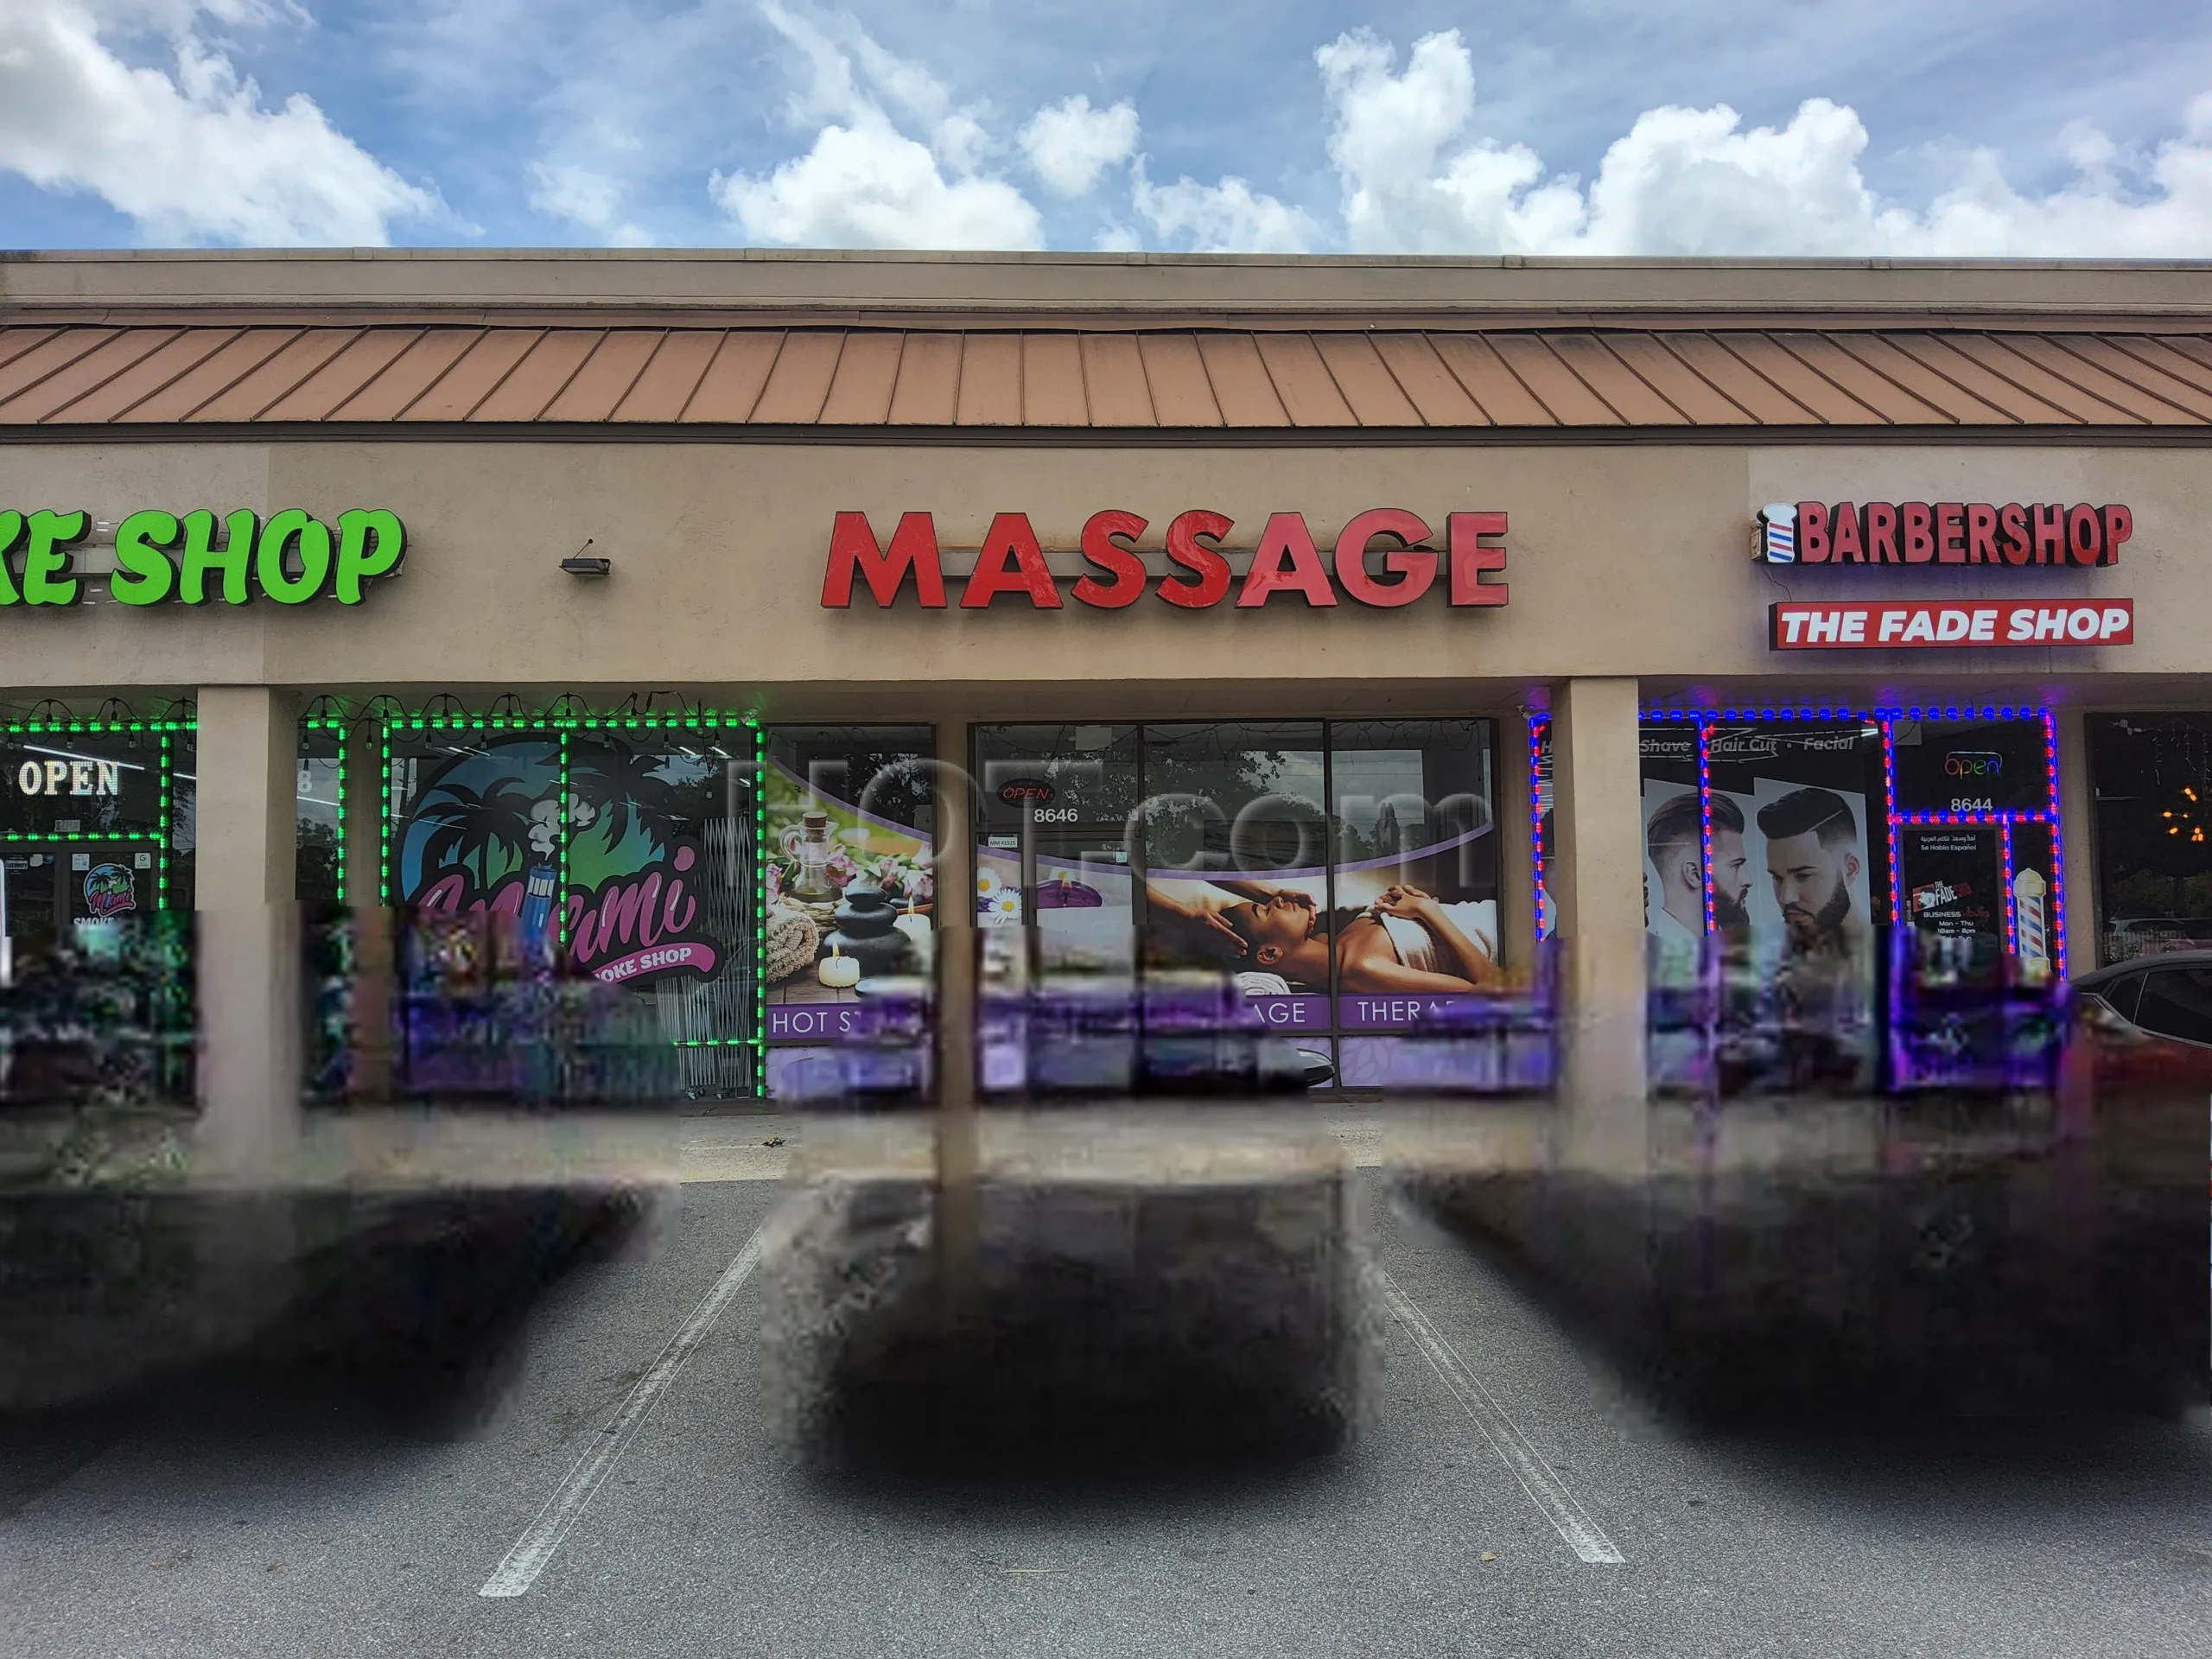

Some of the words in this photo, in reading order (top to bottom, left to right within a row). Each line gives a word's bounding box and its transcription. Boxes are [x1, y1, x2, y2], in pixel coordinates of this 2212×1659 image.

[1797, 501, 2133, 568] BARBERSHOP
[111, 508, 408, 606] SHOP
[819, 507, 1508, 609] MASSAGE
[1781, 611, 1867, 643] THE
[1878, 609, 1998, 642] FADE
[2007, 608, 2130, 640] SHOP
[1640, 738, 1690, 753] Shave
[1710, 738, 1745, 753] Hair
[1749, 737, 1777, 752] Cut
[1803, 736, 1854, 751] Facial
[18, 760, 118, 796] OPEN
[1002, 785, 1051, 800] OPEN
[1033, 808, 1079, 823] 8646
[1950, 798, 1993, 812] 8644
[1950, 843, 1977, 852] Español
[1935, 880, 1944, 889] THE
[1935, 886, 1958, 906] FADE
[594, 959, 638, 982] OKE
[640, 947, 692, 969] SHOP
[772, 1012, 828, 1033] HOT
[1357, 1001, 1457, 1023] THER
